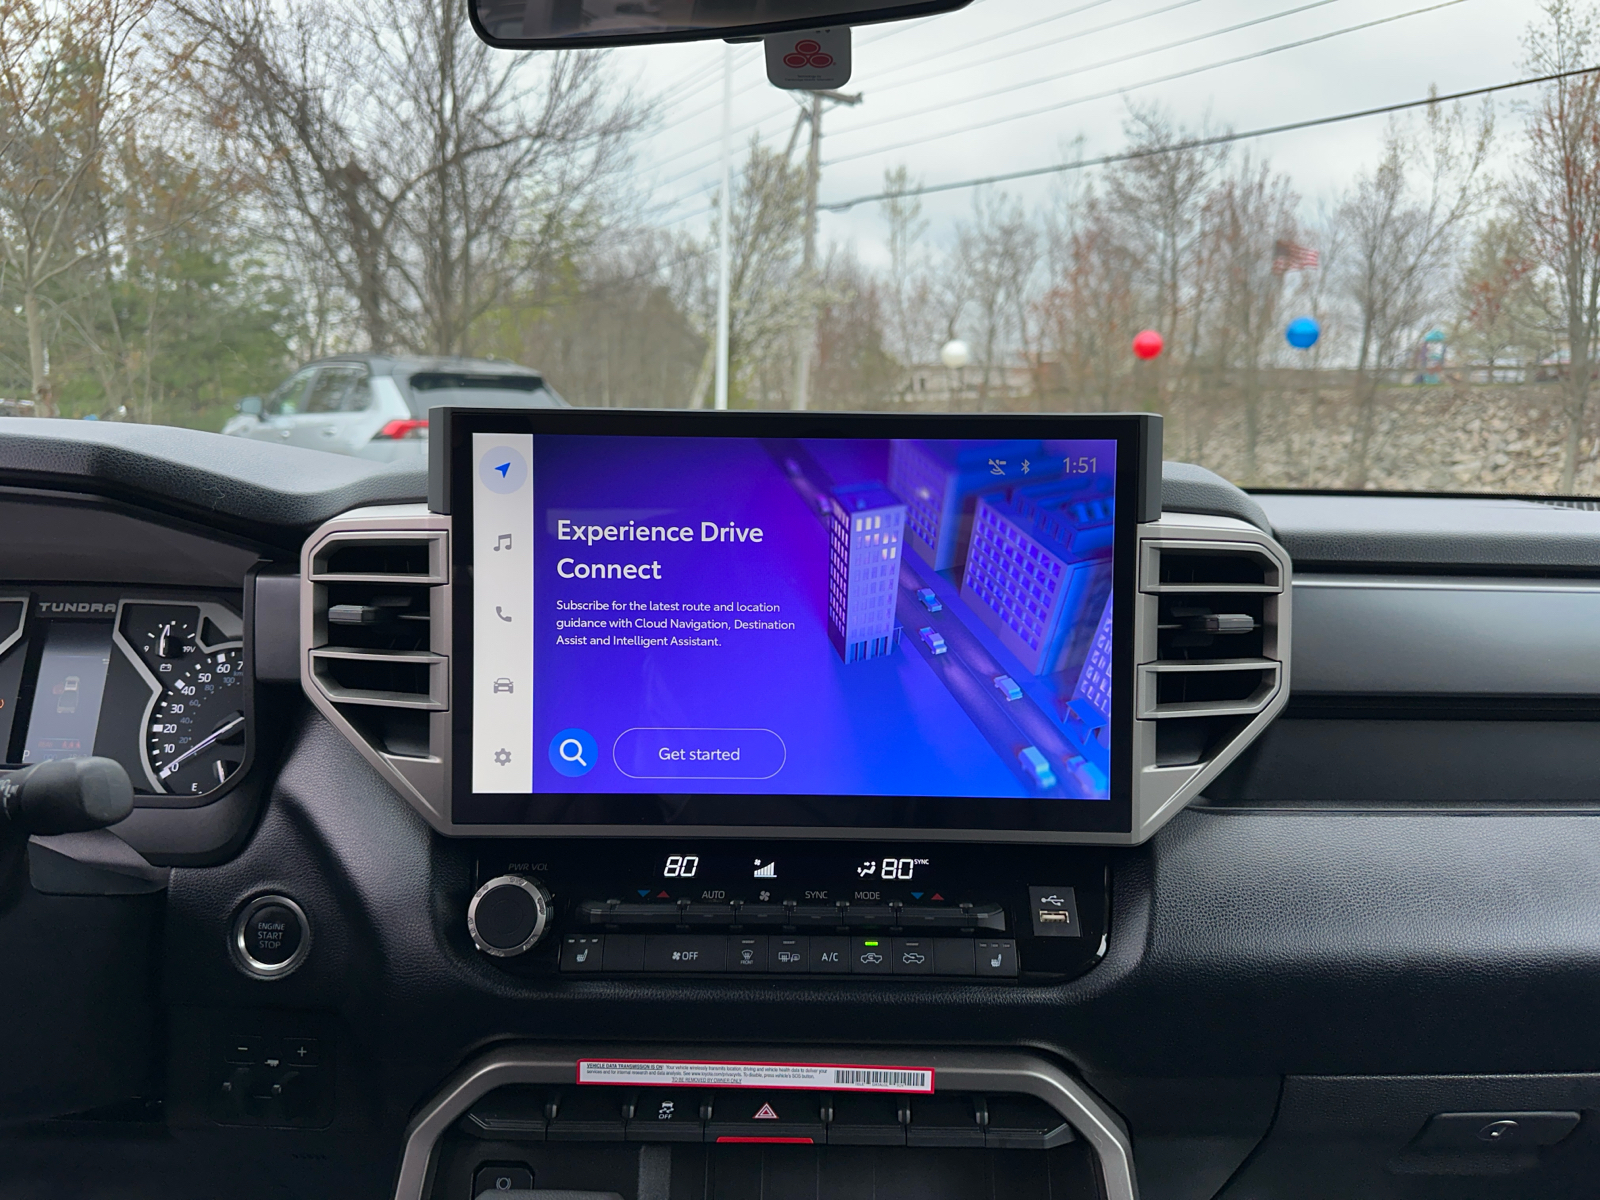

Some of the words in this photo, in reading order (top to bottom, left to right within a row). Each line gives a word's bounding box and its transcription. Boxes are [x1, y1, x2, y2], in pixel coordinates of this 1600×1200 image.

[1063, 457, 1096, 473] 1:51
[557, 520, 694, 546] Experience
[700, 521, 764, 542] Drive
[556, 558, 662, 580] Connect
[39, 602, 116, 612] TUNDRA
[556, 600, 610, 611] Subscribe
[612, 600, 627, 611] for
[629, 600, 647, 611] the
[649, 601, 680, 612] latest
[682, 602, 711, 612] route
[713, 602, 734, 612] and
[736, 602, 780, 612] location
[556, 618, 607, 631] guidance
[609, 618, 632, 628] with
[634, 618, 668, 629] Cloud
[670, 619, 731, 631] Navigation,
[734, 619, 795, 630] Destination
[556, 635, 588, 645] Assist
[590, 635, 611, 646] and
[613, 635, 668, 648] Intelligent
[670, 636, 722, 647] Assistant.
[216, 664, 230, 673] 60
[198, 673, 211, 682] 50
[181, 686, 196, 695] 40
[170, 704, 184, 713] 30
[163, 724, 177, 733] 20
[164, 744, 175, 753] 10
[658, 747, 686, 760] Get
[689, 748, 740, 761] started
[172, 762, 179, 772] 0
[192, 783, 198, 791] E
[664, 856, 699, 877] 80
[881, 859, 914, 879] 80
[258, 932, 283, 940] START
[259, 940, 281, 949] STOP
[682, 952, 698, 960] OFF
[821, 952, 839, 961] A/C
